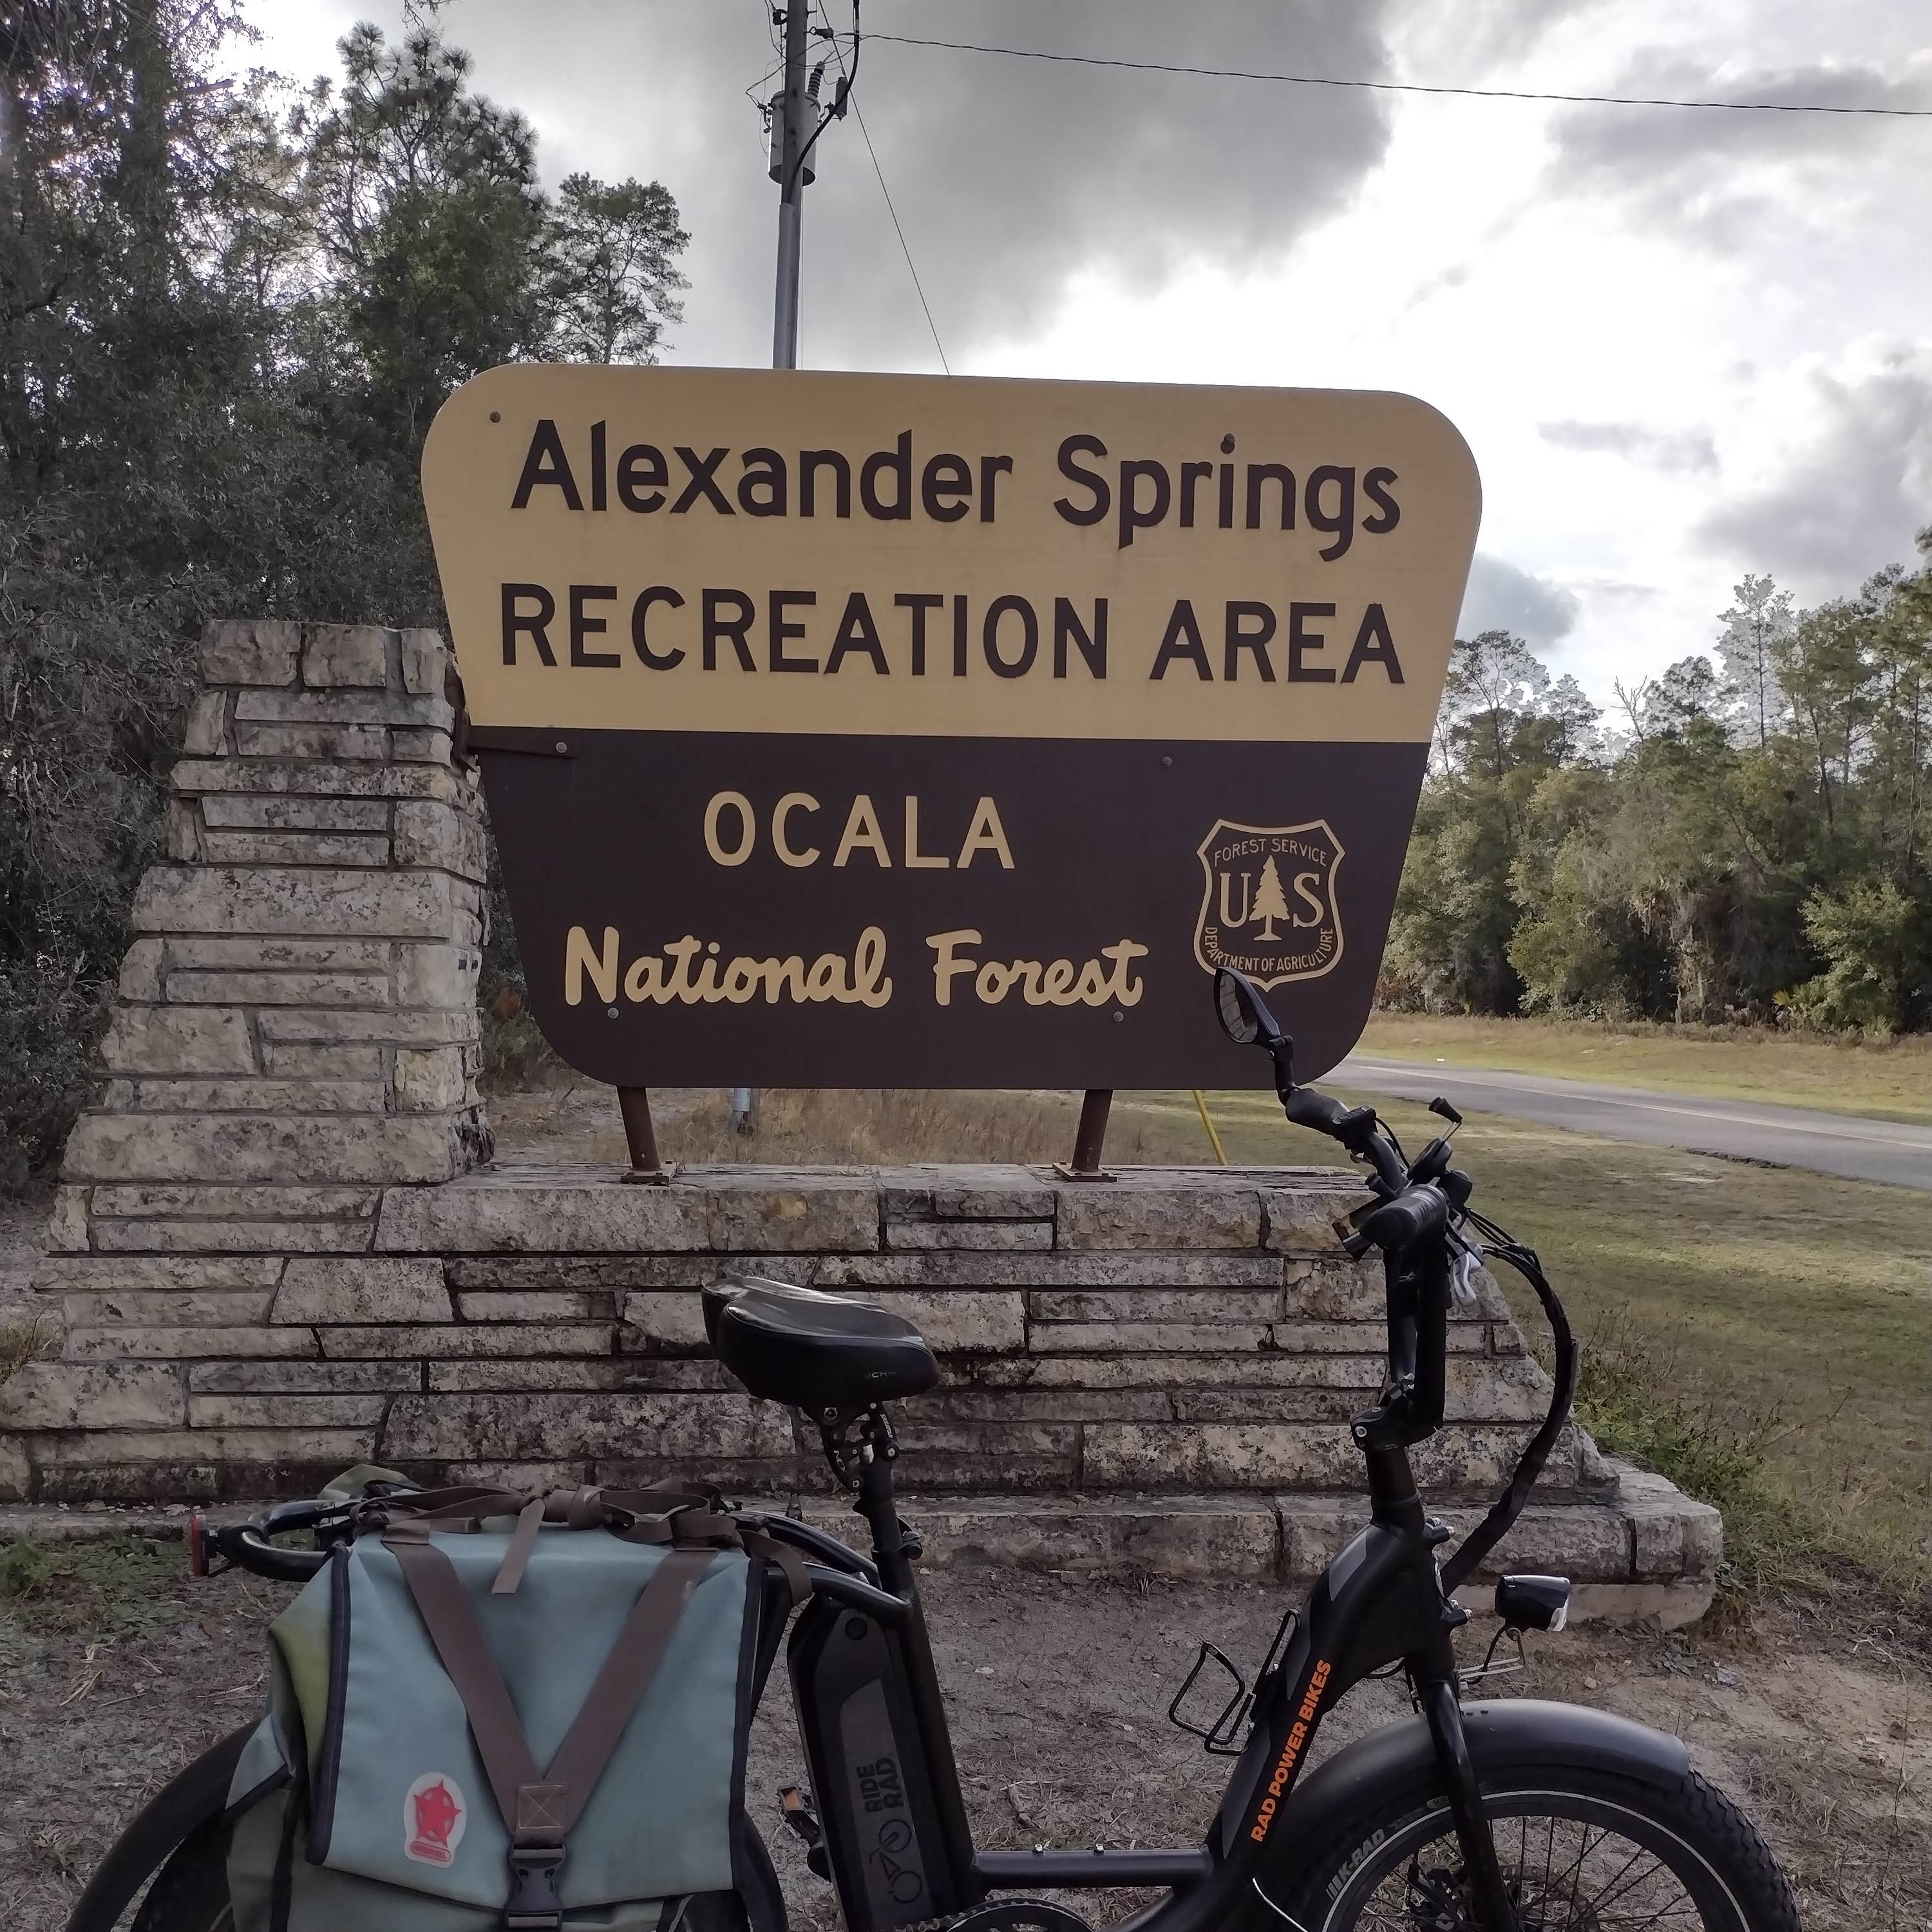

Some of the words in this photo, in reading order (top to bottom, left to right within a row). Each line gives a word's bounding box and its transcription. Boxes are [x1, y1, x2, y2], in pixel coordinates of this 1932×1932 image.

[511, 419, 1014, 523] Alexander
[1054, 433, 1401, 562] Springs
[501, 583, 1108, 679] RECREATION
[1149, 599, 1405, 684] AREA
[704, 791, 1015, 869] OCALA
[1214, 838, 1267, 867] FOREST
[1271, 838, 1327, 867] SERVICE
[565, 926, 893, 1009] National
[925, 929, 1149, 1007] Forest
[1204, 927, 1259, 972] DEPARTMENT
[1261, 958, 1276, 972] OF
[1276, 927, 1333, 971] AGRICULTURE
[855, 1763, 882, 1814] RIDE
[875, 1757, 904, 1810] RAD
[1250, 1797, 1276, 1842] RAD
[1268, 1721, 1308, 1797] POWER
[1298, 1659, 1331, 1721] BIKES
